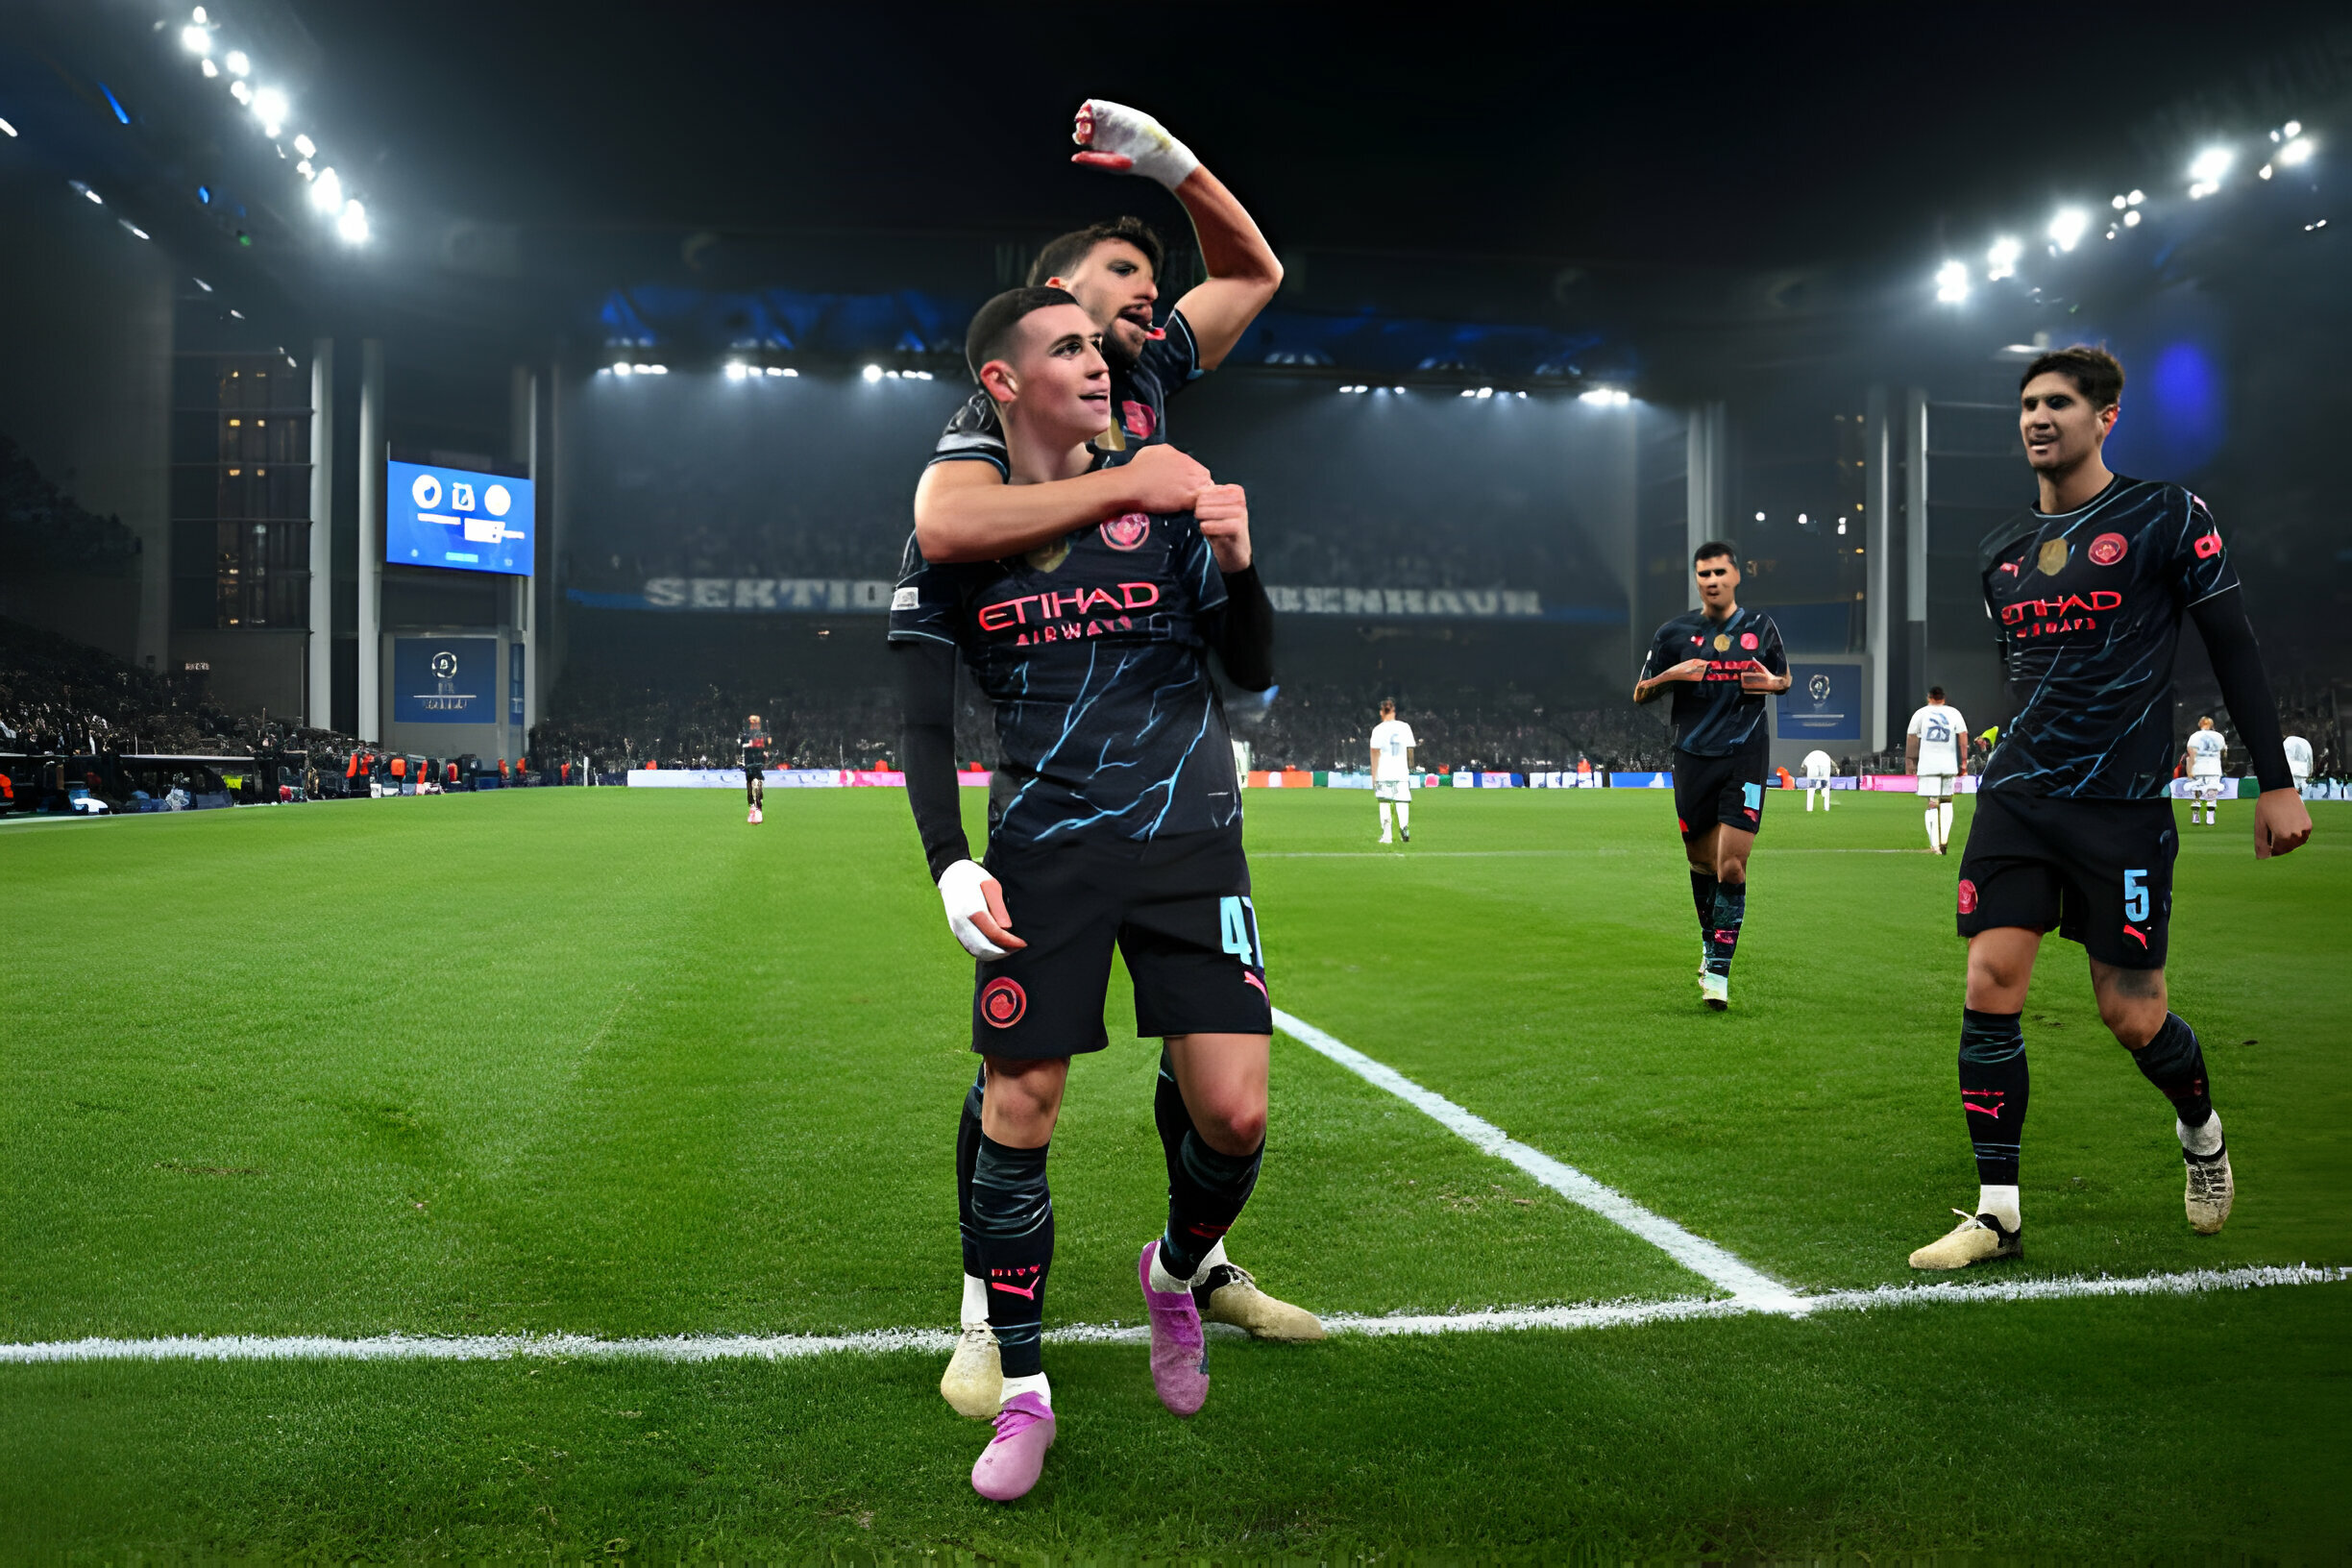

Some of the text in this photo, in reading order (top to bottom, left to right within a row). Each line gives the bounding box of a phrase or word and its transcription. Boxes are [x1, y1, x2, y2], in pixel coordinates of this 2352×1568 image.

[644, 577, 894, 608] SEKTIO
[978, 582, 1160, 631] ETIHAD
[2124, 869, 2150, 922] 5
